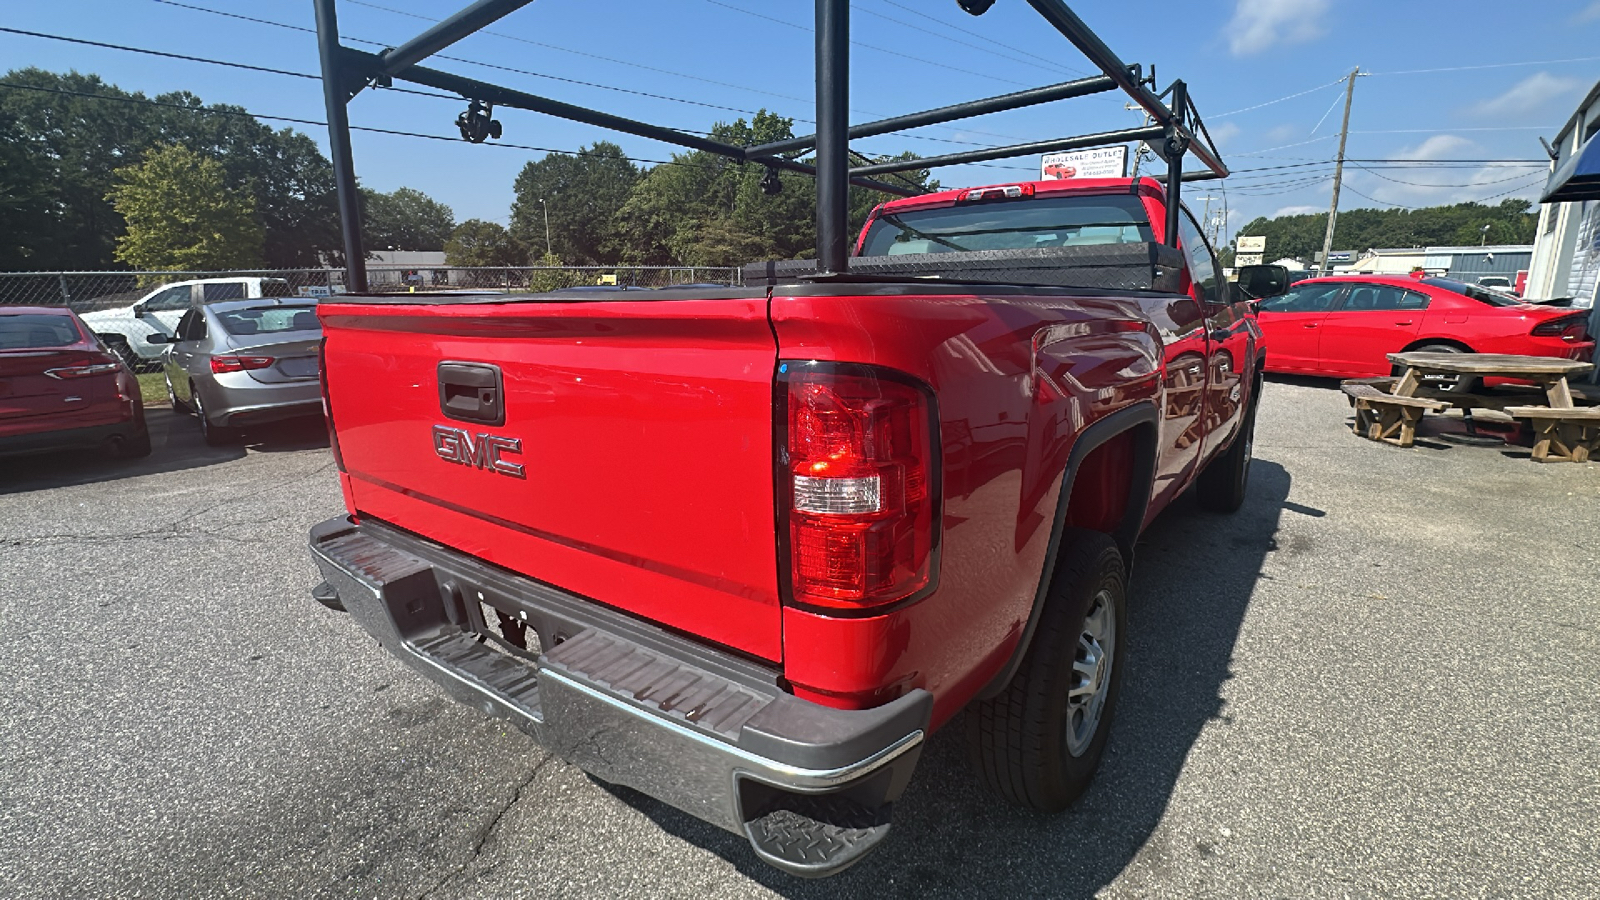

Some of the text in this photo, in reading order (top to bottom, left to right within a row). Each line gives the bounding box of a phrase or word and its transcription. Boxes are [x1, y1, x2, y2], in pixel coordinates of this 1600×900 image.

[1044, 154, 1089, 164] WHOLESALE
[1092, 150, 1123, 159] OUTLET
[432, 424, 525, 478] GMC
